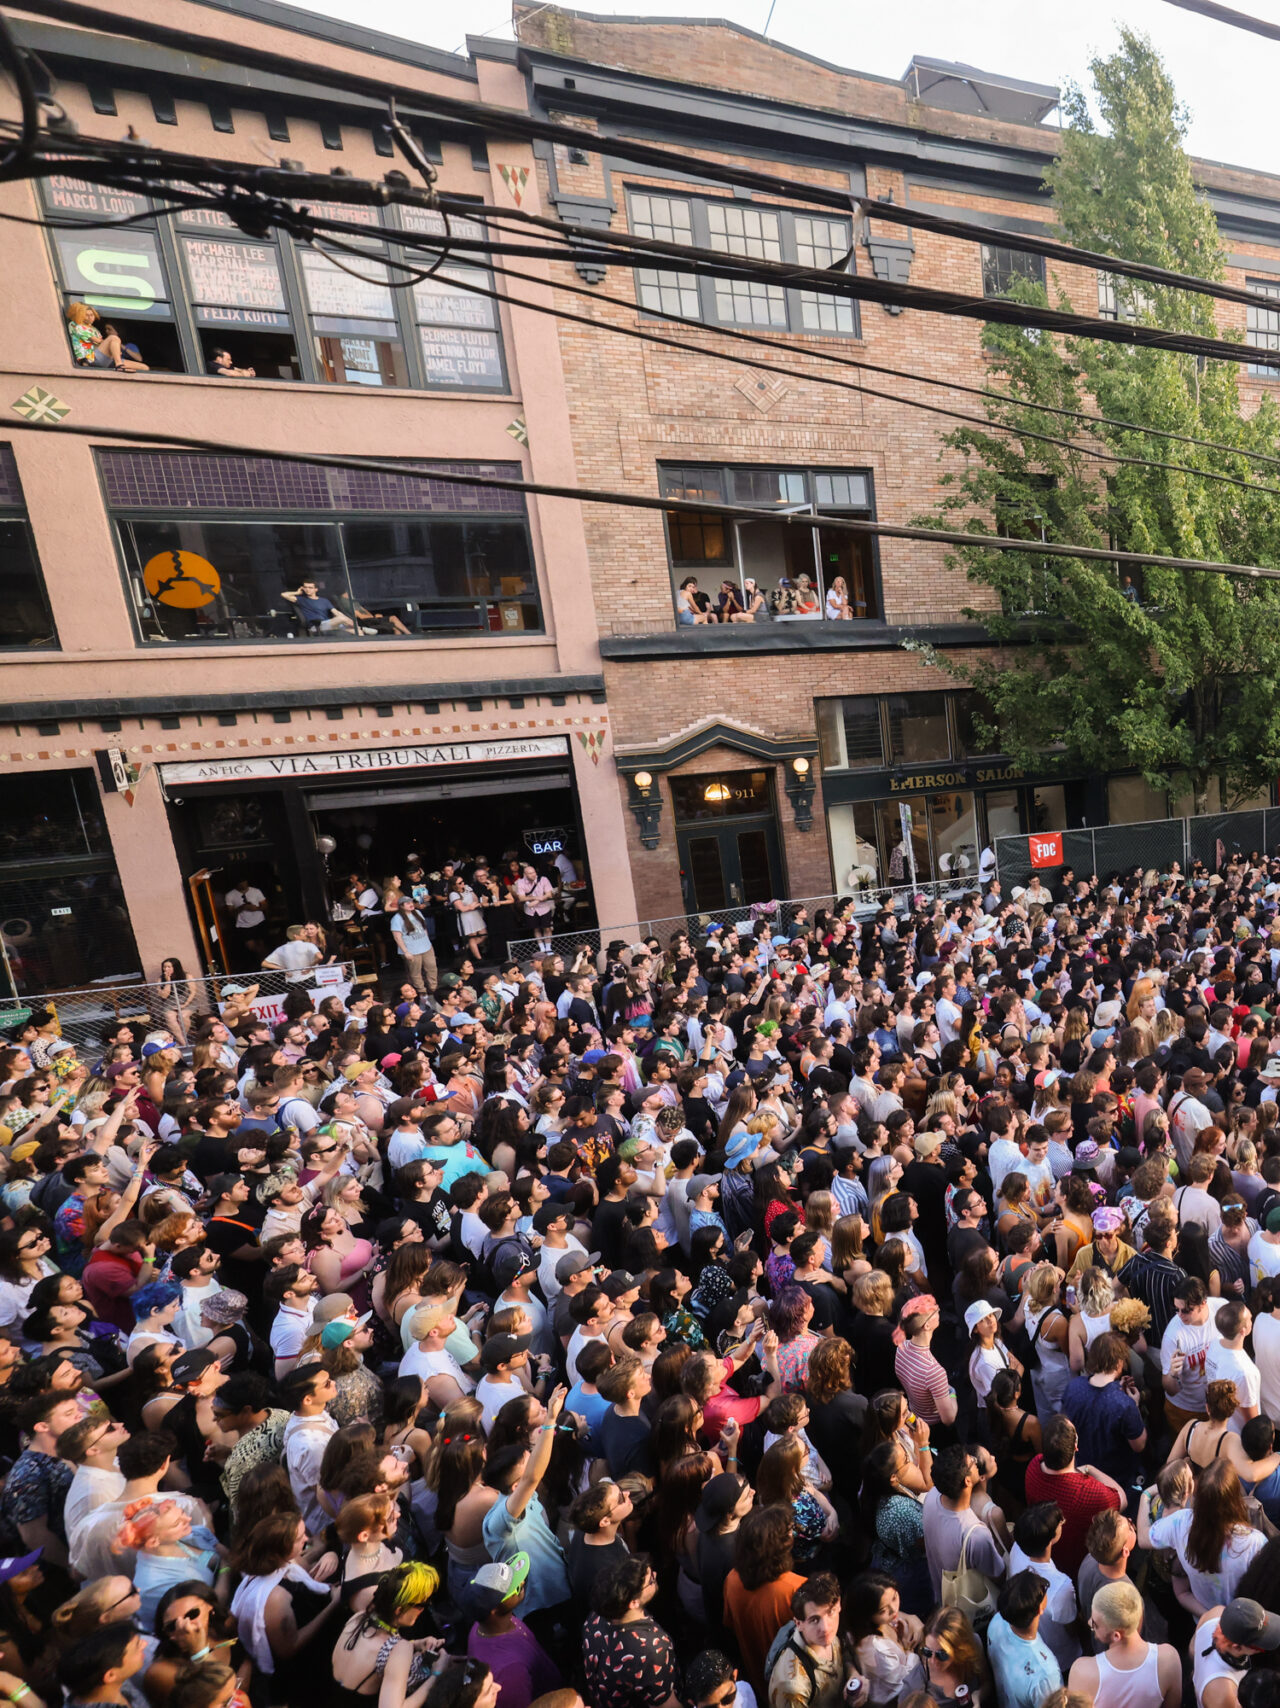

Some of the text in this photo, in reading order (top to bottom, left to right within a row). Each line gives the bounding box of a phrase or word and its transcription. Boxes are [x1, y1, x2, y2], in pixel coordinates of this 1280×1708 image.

[52, 190, 137, 215] MARCO LOUD
[180, 208, 225, 226] BETTIE
[405, 215, 442, 234] DARIUS
[186, 240, 266, 262] MICHAEL LEE
[188, 254, 252, 272] MARSHALL
[203, 306, 241, 321] FELIX
[421, 328, 490, 347] GEORGE FLOYD
[427, 358, 487, 375] JAMEL FLOYD
[197, 743, 542, 777] ANTICA VIA TRIBUNALI PIZZERIA
[889, 767, 1026, 791] EMERSON SALON
[735, 788, 756, 800] 911
[533, 840, 563, 854] BAR
[1036, 842, 1057, 859] FDC
